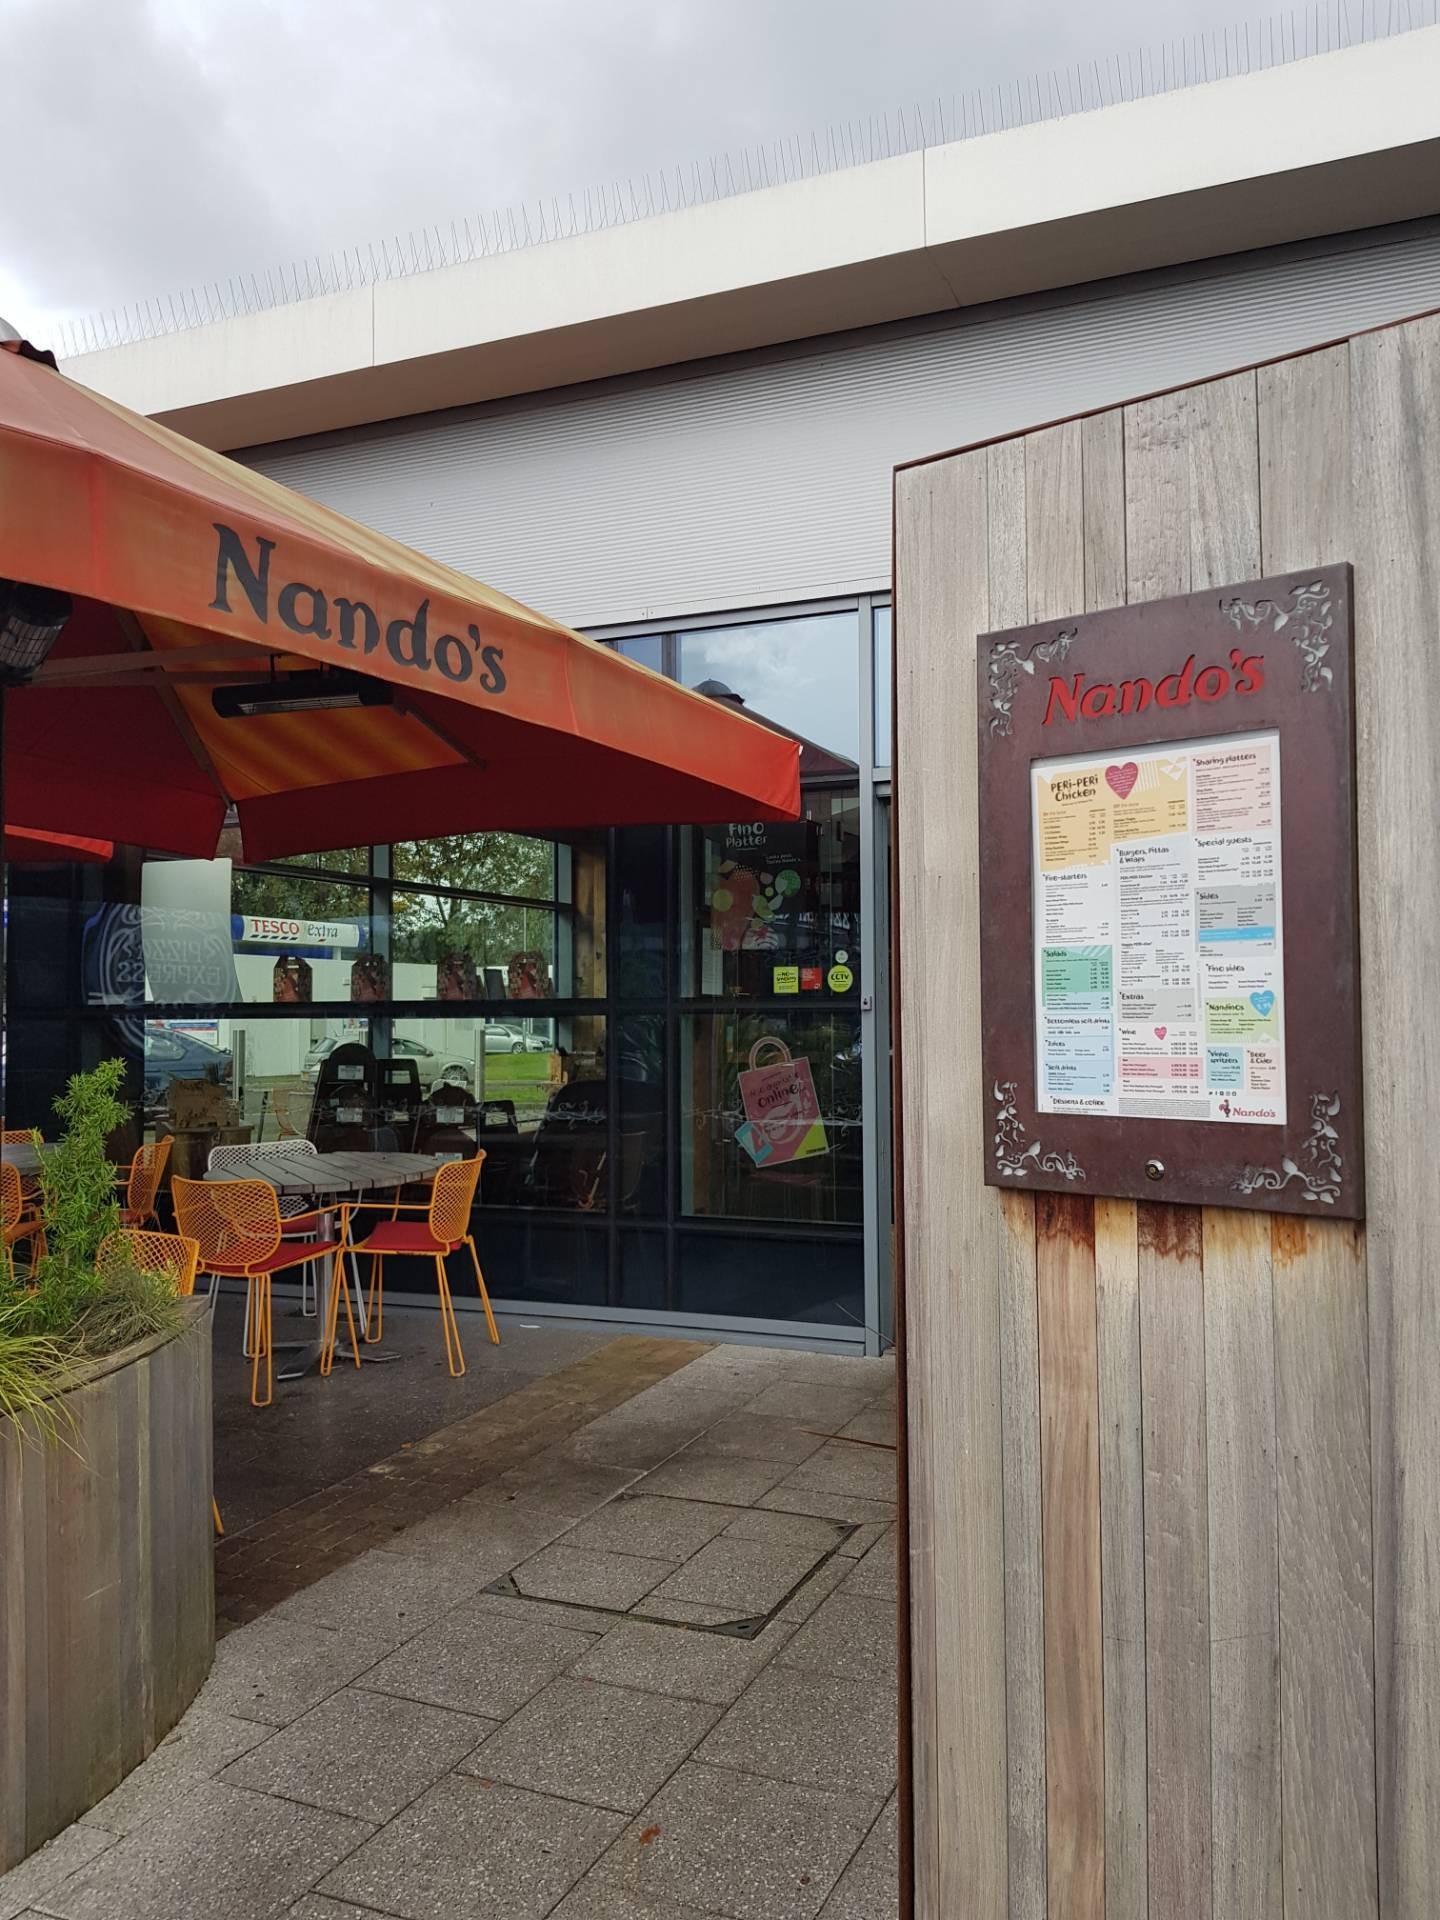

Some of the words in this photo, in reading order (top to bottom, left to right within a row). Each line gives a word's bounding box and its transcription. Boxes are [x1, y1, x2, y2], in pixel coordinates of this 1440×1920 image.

[208, 523, 507, 694] Nando's
[1042, 648, 1265, 727] Nando's
[1196, 757, 1224, 766] Sharing
[1055, 788, 1096, 802] Chicken
[725, 835, 768, 849] Platter
[1197, 837, 1225, 847] Special
[1226, 836, 1252, 846] guests
[1199, 892, 1219, 900] Sides
[251, 919, 300, 935] TESCO
[307, 924, 339, 939] extra
[830, 973, 850, 981] CCTV
[1121, 992, 1144, 1000] Extras
[1232, 1107, 1276, 1118] Nando's
